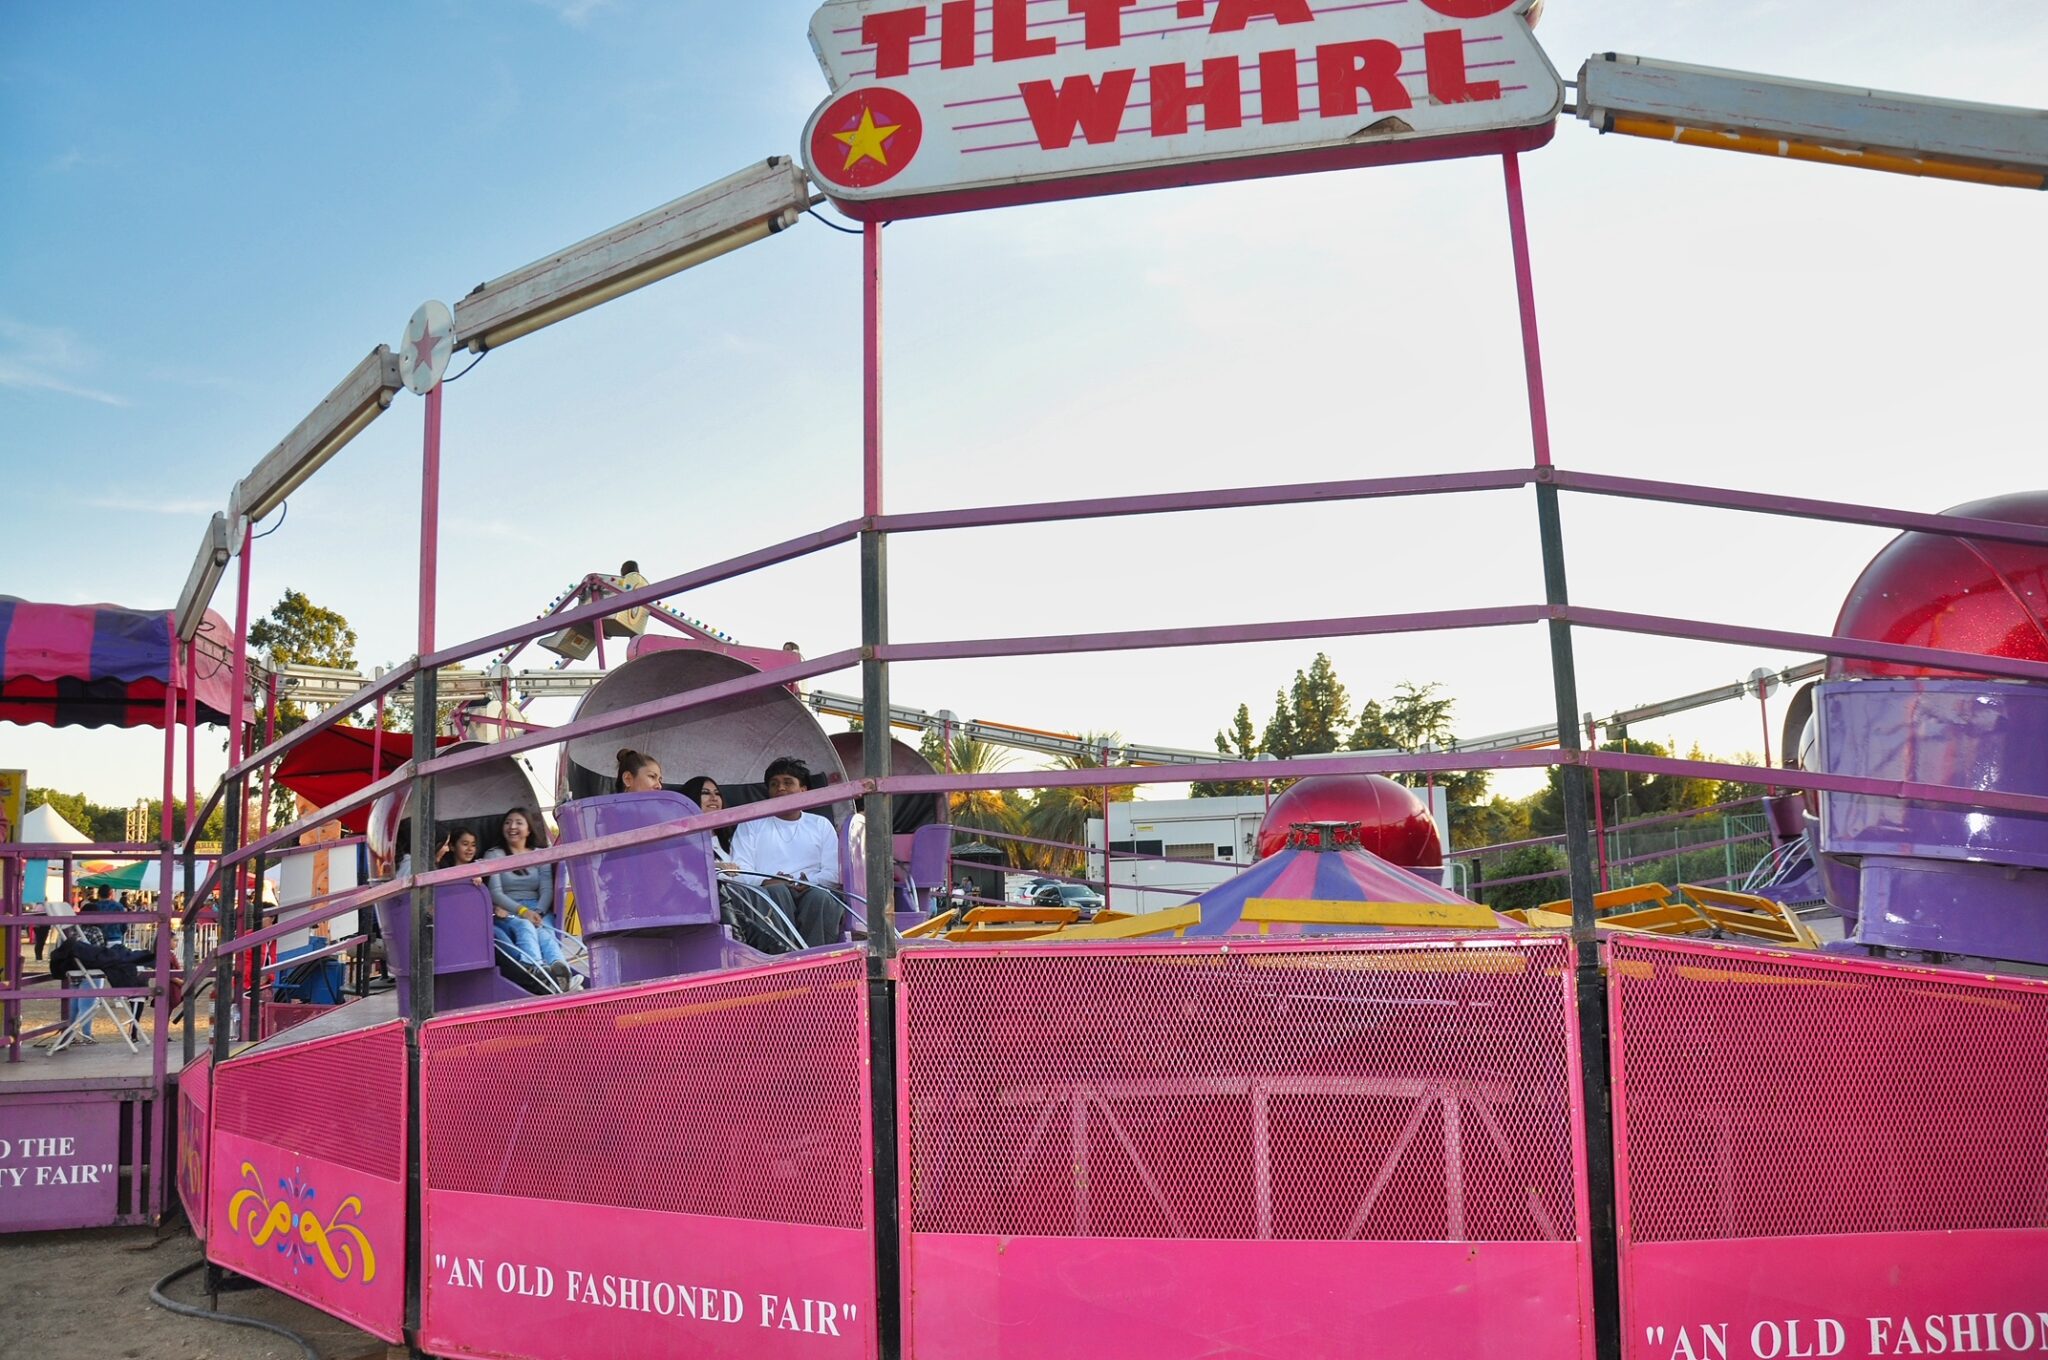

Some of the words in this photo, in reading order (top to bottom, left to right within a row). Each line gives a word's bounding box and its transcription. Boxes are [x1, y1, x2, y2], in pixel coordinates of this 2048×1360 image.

[1018, 29, 1500, 150] WHIRL
[18, 1137, 75, 1157] THE
[35, 1163, 113, 1186] FAIR"
[435, 1254, 484, 1289] "AN
[496, 1261, 554, 1297] OLD
[566, 1270, 744, 1324] FASHIONED
[759, 1293, 857, 1337] FAIR"
[1646, 1323, 1728, 1360] "AN
[1750, 1318, 1845, 1359] OLD
